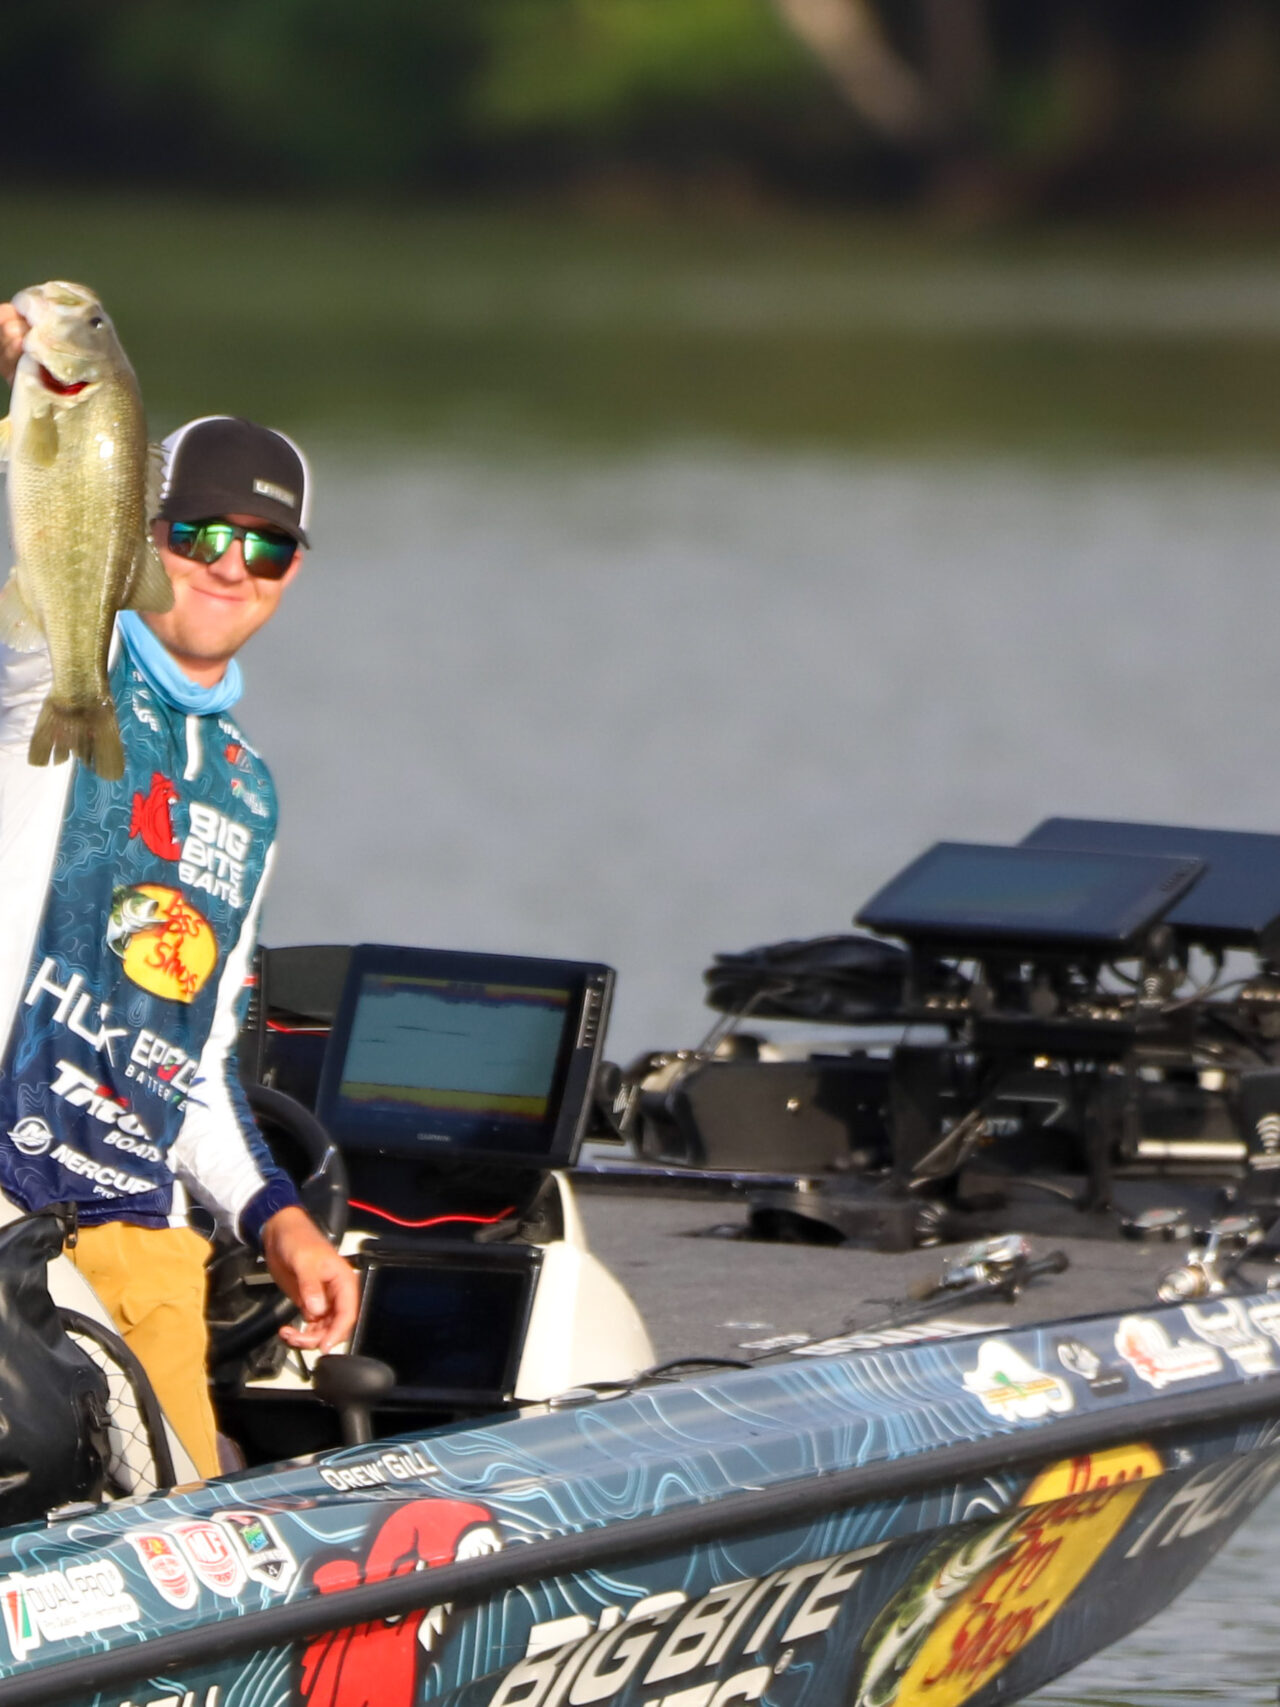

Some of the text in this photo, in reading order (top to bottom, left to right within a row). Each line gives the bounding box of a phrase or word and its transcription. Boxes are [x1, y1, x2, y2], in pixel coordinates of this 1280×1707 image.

[189, 802, 251, 861] BIG
[178, 861, 242, 909] BAITS
[181, 834, 246, 889] BITE
[124, 1063, 188, 1113] BATTERE
[102, 1130, 161, 1163] BOATS
[320, 1452, 439, 1491] DREW GILL
[26, 1581, 82, 1614] DUAL
[74, 1571, 115, 1601] PRO
[488, 1540, 893, 1707] BIG BITE
